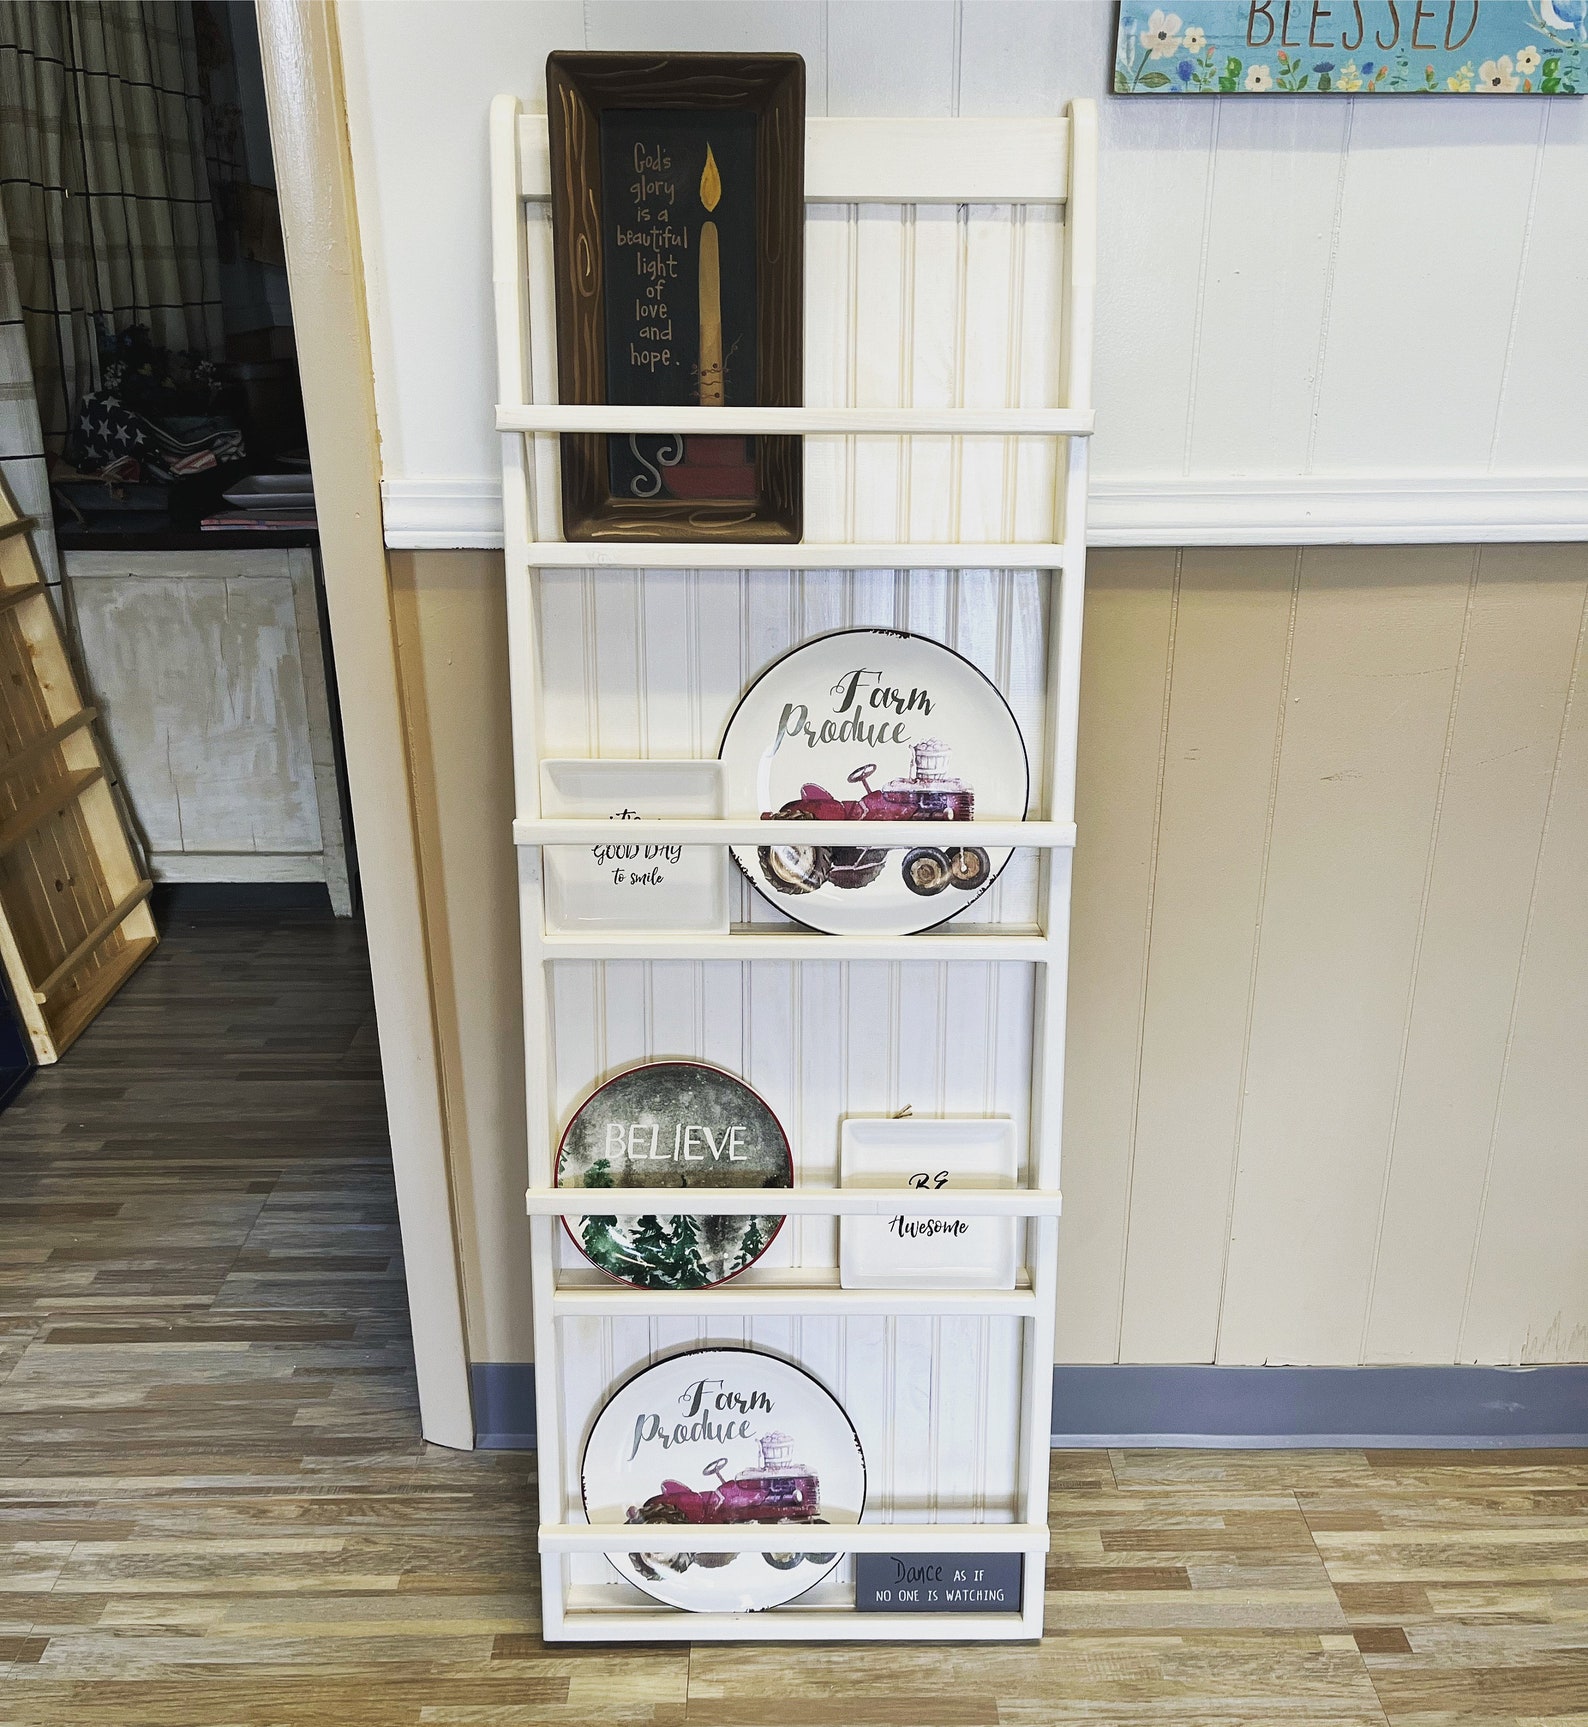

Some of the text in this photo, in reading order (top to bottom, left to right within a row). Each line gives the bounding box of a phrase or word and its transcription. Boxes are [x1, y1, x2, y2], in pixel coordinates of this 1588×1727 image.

[1246, 0, 1479, 51] BLESSED
[634, 142, 671, 173] God's
[630, 175, 675, 205] glory
[637, 207, 668, 222] is a
[616, 225, 688, 252] beautiful
[637, 252, 678, 280] light
[646, 279, 666, 300] of
[636, 299, 668, 321] love
[639, 319, 672, 341] and
[630, 343, 680, 373] hope.
[830, 667, 936, 716] Farm
[772, 702, 911, 758] Produce
[611, 866, 664, 886] to smile
[605, 1123, 748, 1161] BELIEVE
[888, 1214, 969, 1238] Awesome
[678, 1378, 775, 1417] Farm
[627, 1409, 756, 1461] Produce
[890, 1556, 985, 1584] Dance AS IF
[876, 1588, 1005, 1602] NO ONE IS WATCHING
